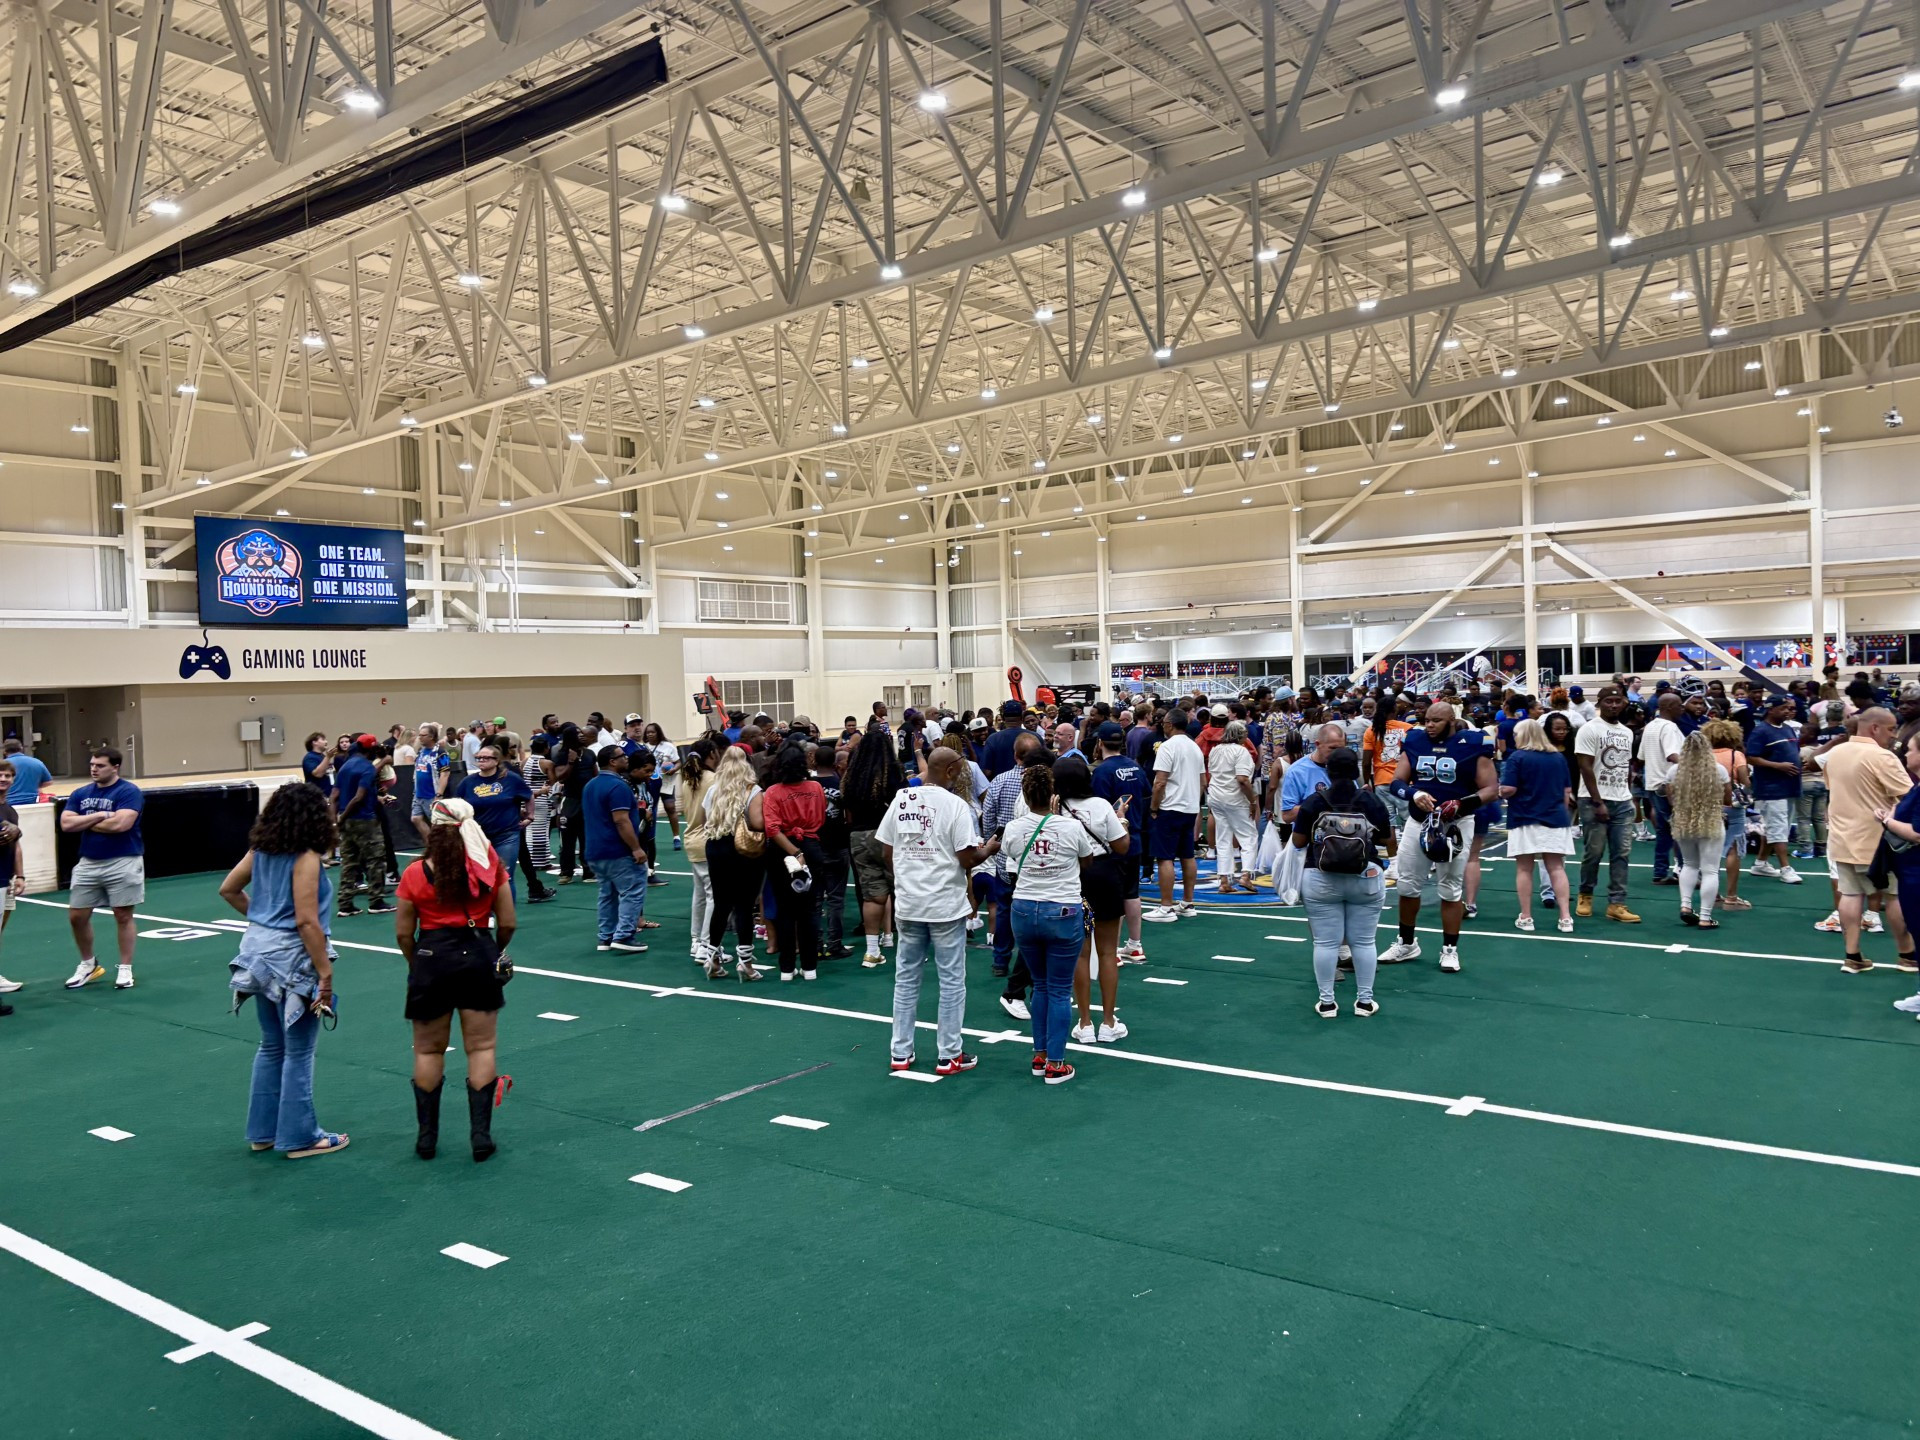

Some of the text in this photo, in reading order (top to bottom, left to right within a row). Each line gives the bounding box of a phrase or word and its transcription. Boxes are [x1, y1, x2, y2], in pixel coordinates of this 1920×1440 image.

[319, 545, 386, 562] ONE TEAM.
[320, 563, 389, 579] ONE TOWN.
[222, 580, 265, 597] HOUND
[313, 580, 398, 597] ONE MISSION.
[242, 648, 367, 669] GAMING LOUNGE
[697, 693, 710, 710] 2
[1415, 755, 1457, 784] 58
